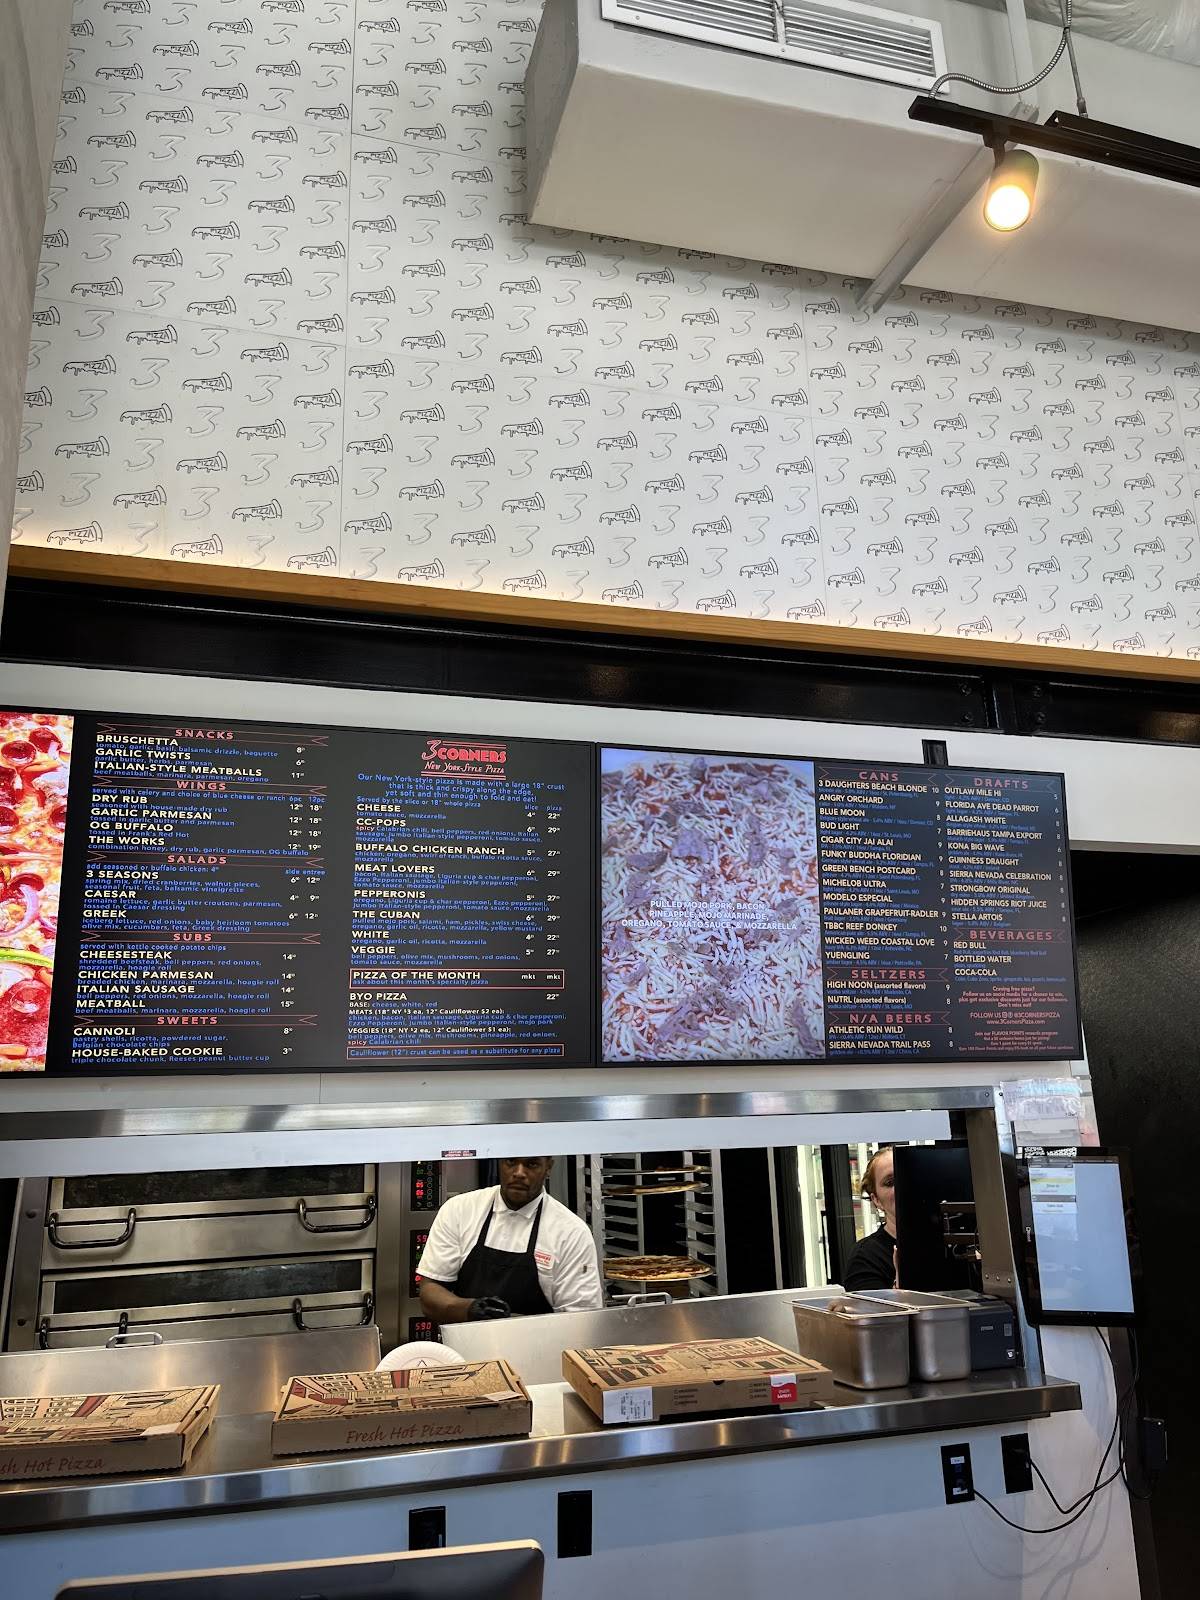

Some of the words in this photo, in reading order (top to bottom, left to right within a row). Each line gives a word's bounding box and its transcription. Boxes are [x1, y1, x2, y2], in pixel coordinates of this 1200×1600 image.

[175, 729, 234, 739] SNACKS
[97, 735, 178, 746] BRUSCHETTA
[96, 749, 145, 757] GARLIC
[147, 751, 191, 760] TWISTS
[438, 748, 507, 763] CORNERS
[94, 762, 186, 773] ITALIAN-STYLE
[191, 766, 262, 776] MEATBALLS
[859, 772, 899, 782] CANS
[177, 781, 227, 790] WINGS
[825, 781, 870, 790] DAUGHTERS
[872, 783, 896, 791] BEACH
[898, 784, 927, 792] BLONDE
[974, 778, 1029, 790] DRAFTS
[945, 787, 975, 796] OUTLAW
[976, 789, 993, 797] MILE
[92, 795, 120, 803] DRY
[122, 796, 148, 804] RUB
[819, 794, 845, 803] ANGRY
[847, 795, 883, 804] ORCHARD
[357, 804, 401, 812] CHEESE
[945, 801, 974, 809] FLORIDA
[991, 803, 1011, 811] DEAD
[1013, 804, 1039, 813] PARROT
[91, 808, 140, 817] GARLIC
[143, 810, 212, 819] PARMESAN
[820, 808, 838, 816] BLUE
[840, 809, 865, 817] MOON
[357, 819, 406, 827] CC-POPS
[946, 815, 982, 824] ALLAGASH
[984, 817, 1006, 825] WHITE
[90, 821, 113, 830] OG
[115, 822, 174, 832] BUFFALO
[820, 822, 837, 830] BUD
[838, 822, 859, 830] LIGHT
[947, 829, 990, 838] BARRIEHAUS
[991, 830, 1015, 838] TAMPA
[1016, 831, 1042, 840] EXPORT
[89, 836, 116, 844] THE
[119, 837, 165, 845] WORKS
[821, 836, 842, 844] CIGAR
[864, 837, 875, 845] JAI
[355, 844, 408, 852] BUFFALO
[412, 845, 463, 853] CHICKEN
[467, 847, 505, 855] RANCH
[948, 843, 969, 851] KONA
[983, 844, 1004, 852] WAVE
[821, 850, 846, 858] FUNKY
[848, 851, 880, 859] BUDDHA
[882, 852, 921, 860] FLORIDIAN
[168, 856, 227, 864] SALADS
[948, 857, 981, 865] GUINNESS
[983, 858, 1018, 866] DRAUGHT
[355, 864, 387, 872] MEAT
[391, 865, 435, 873] LOVERS
[822, 864, 848, 873] GREEN
[850, 865, 875, 873] BENCH
[877, 866, 916, 875] POSTCARD
[99, 871, 159, 880] SEASONS
[950, 871, 974, 879] SIERRA
[975, 872, 1004, 880] NEVADA
[1005, 873, 1051, 881] CELEBRATION
[823, 879, 861, 887] MICHELOB
[863, 879, 886, 887] ULTRA
[354, 890, 426, 898] PEPPERONIS
[950, 885, 994, 893] STRONGBOW
[995, 886, 1030, 894] ORIGINAL
[85, 890, 137, 899] CAESAR
[823, 893, 857, 901] MODELO
[859, 894, 892, 902] ESPECIAL
[951, 899, 978, 907] HIDDEN
[980, 899, 1008, 908] SPRINGS
[1010, 900, 1027, 908] RIOT
[1028, 900, 1047, 908] JUICE
[83, 910, 127, 918] GREEK
[380, 911, 420, 919] CUBAN
[824, 908, 864, 916] PAULANER
[952, 913, 977, 921] STELLA
[978, 913, 1002, 921] ARTOIS
[744, 922, 797, 930] MOZZARELLA
[824, 922, 843, 930] TBBC
[866, 923, 897, 931] DONKEY
[173, 933, 213, 942] SUBS
[352, 931, 390, 939] WHITE
[969, 930, 1053, 940] BEVERAGES
[825, 937, 855, 945] WICKED
[857, 938, 879, 946] WEED
[881, 938, 915, 946] COASTAL
[916, 938, 934, 946] LOVE
[352, 946, 396, 954] VEGGIE
[80, 951, 172, 959] CHEESESTEAK
[826, 951, 870, 960] YUENGLING
[987, 955, 1012, 963] WATER
[78, 971, 138, 979] CHICKEN
[143, 971, 214, 979] PARMESAN
[851, 970, 927, 979] SELTZERS
[77, 985, 130, 993] ITALIAN
[134, 985, 195, 993] SAUSAGE
[827, 981, 847, 989] HIGH
[848, 981, 872, 989] NOON
[828, 995, 852, 1003] NUTRL
[76, 1000, 146, 1008] MEATBALL
[157, 1016, 218, 1024] SWEETS
[850, 1014, 877, 1024] N/A
[886, 1014, 932, 1024] BEERS
[74, 1027, 135, 1036] CANNOLI
[829, 1026, 864, 1034] ATHLETIC
[866, 1026, 882, 1034] RUN
[883, 1026, 903, 1034] WILD
[72, 1048, 168, 1057] HOUSE-BAKED
[173, 1048, 223, 1056] COOKIE
[346, 1424, 386, 1443] Fresh
[390, 1424, 418, 1440] Hot
[421, 1423, 464, 1438] Pizza
[24, 1458, 54, 1474] Hot
[59, 1457, 104, 1472] Pizza
